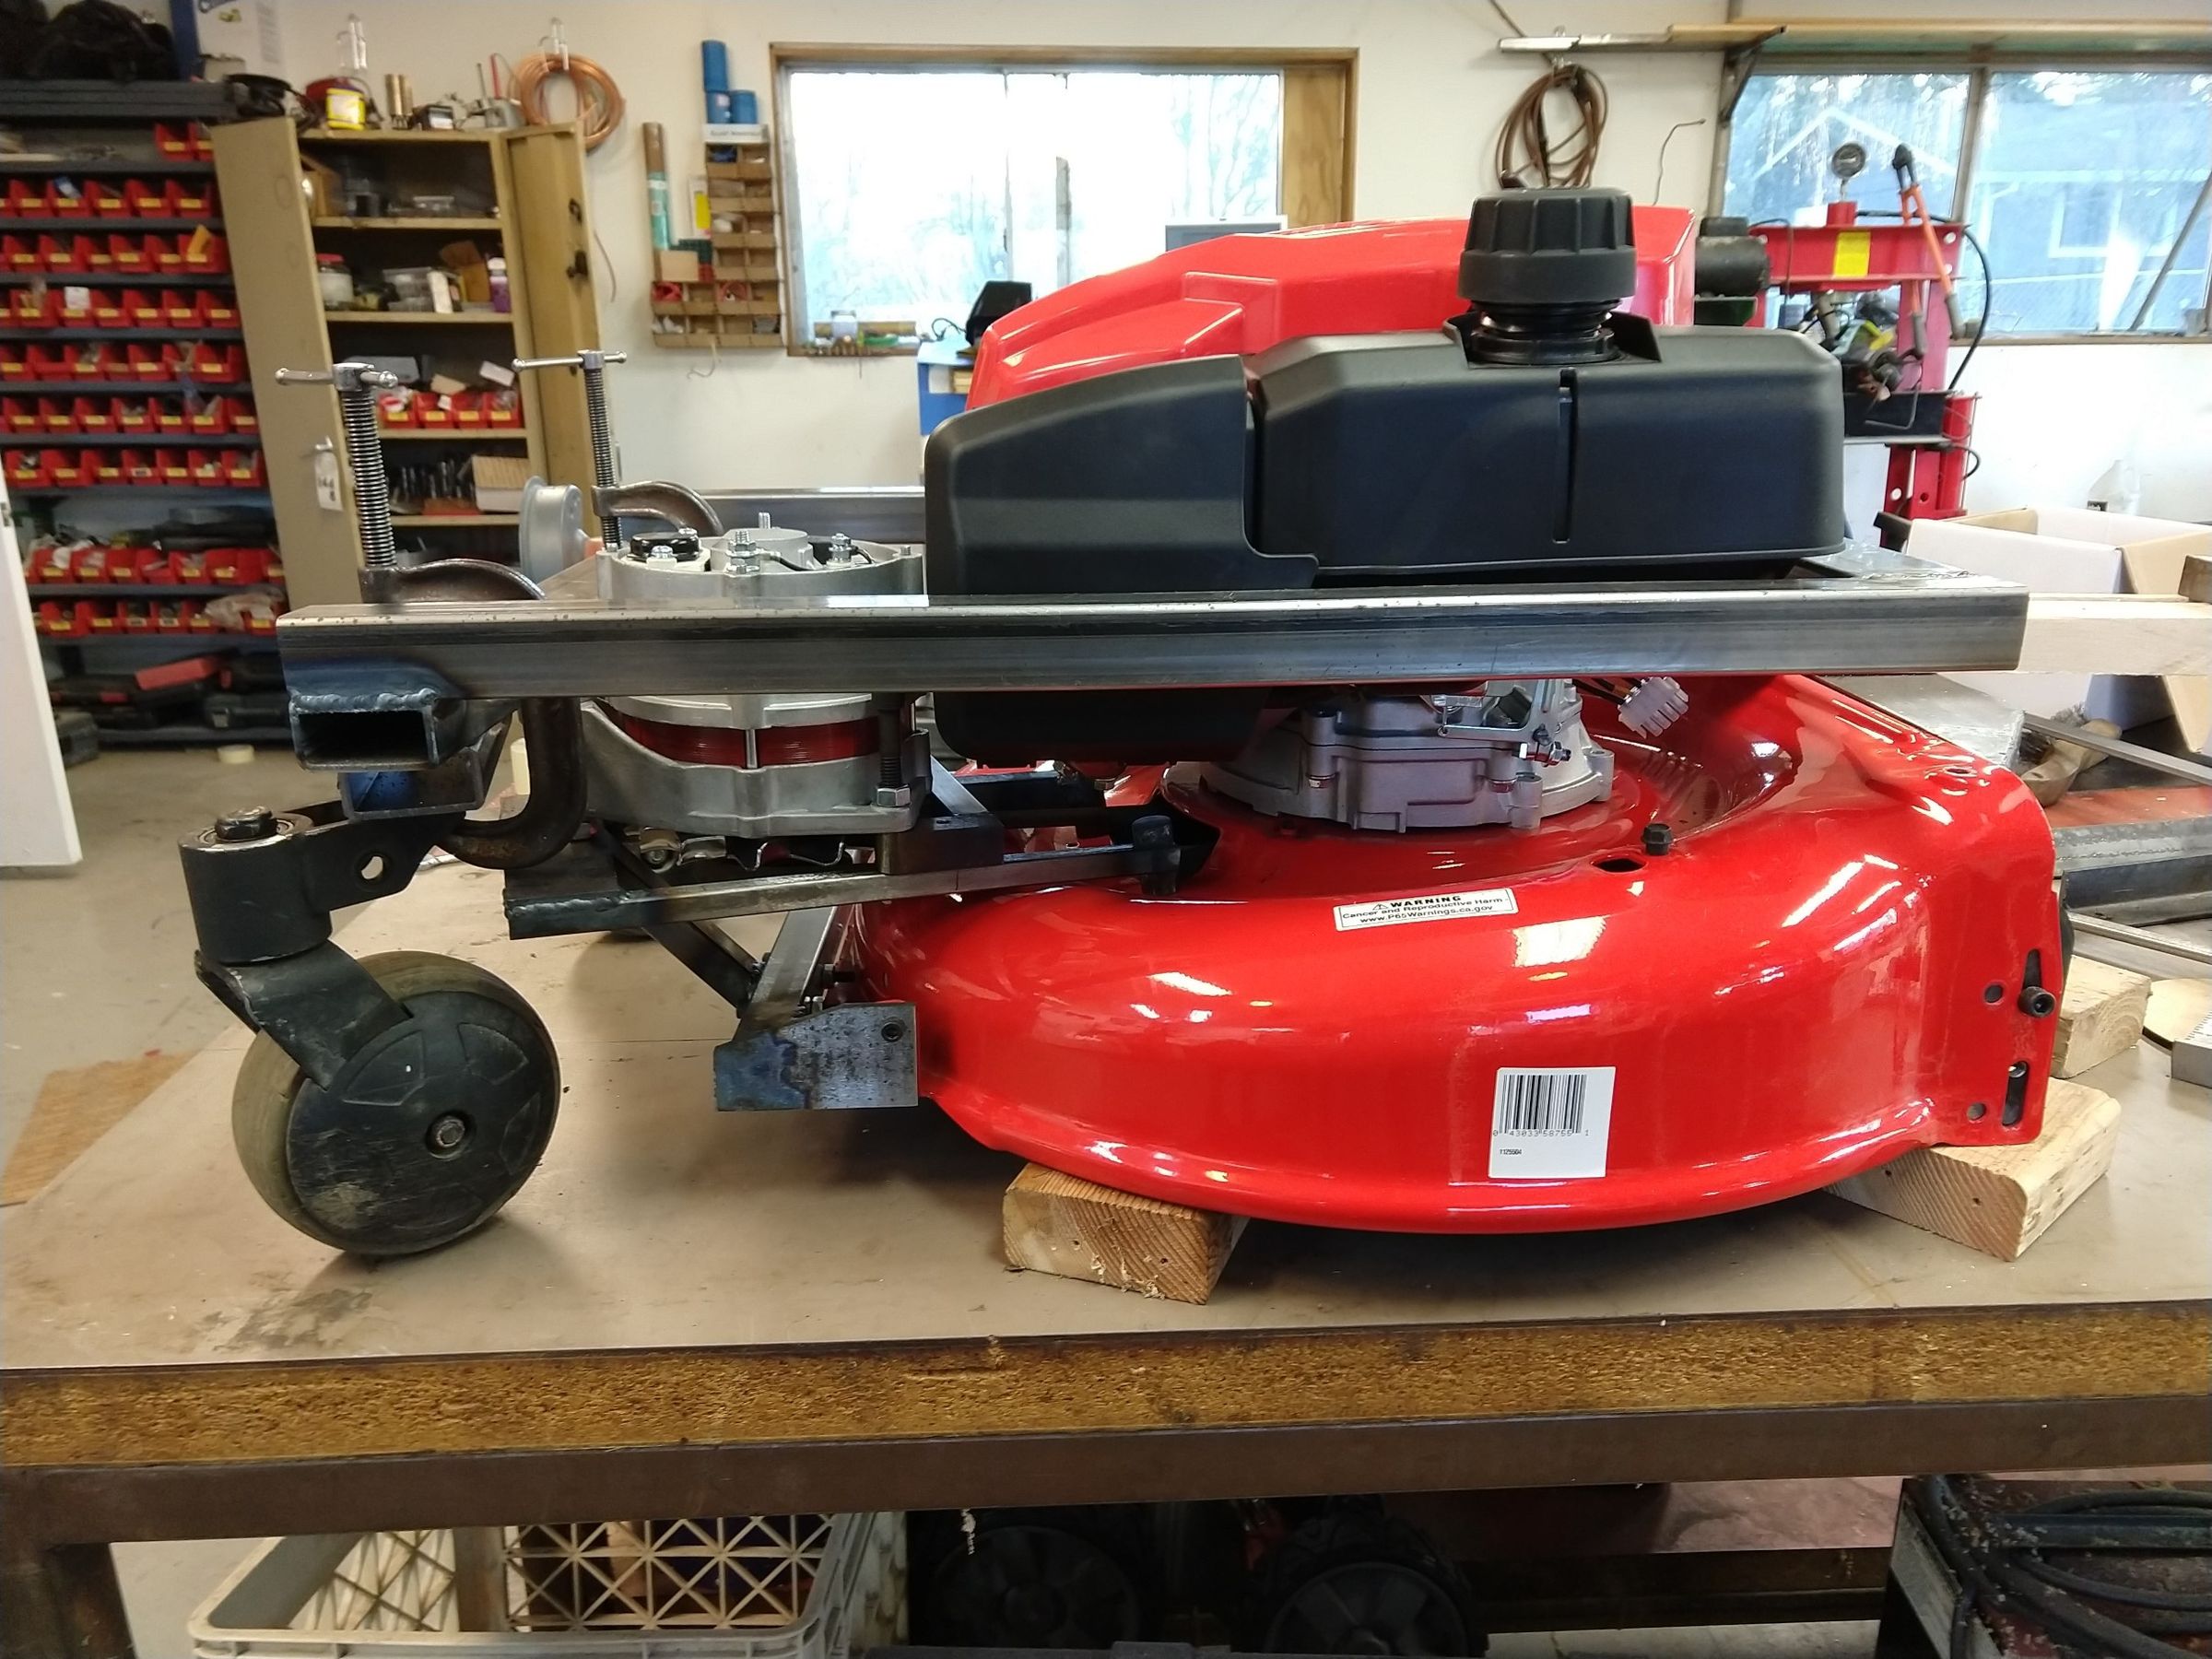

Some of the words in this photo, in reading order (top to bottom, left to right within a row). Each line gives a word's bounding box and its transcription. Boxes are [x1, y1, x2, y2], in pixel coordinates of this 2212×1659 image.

[1343, 910, 1378, 919] Cancer
[1404, 900, 1473, 912] Reproductive
[1390, 896, 1461, 907] WARNING
[1360, 905, 1493, 923] www.P65Warnings.ca.gov
